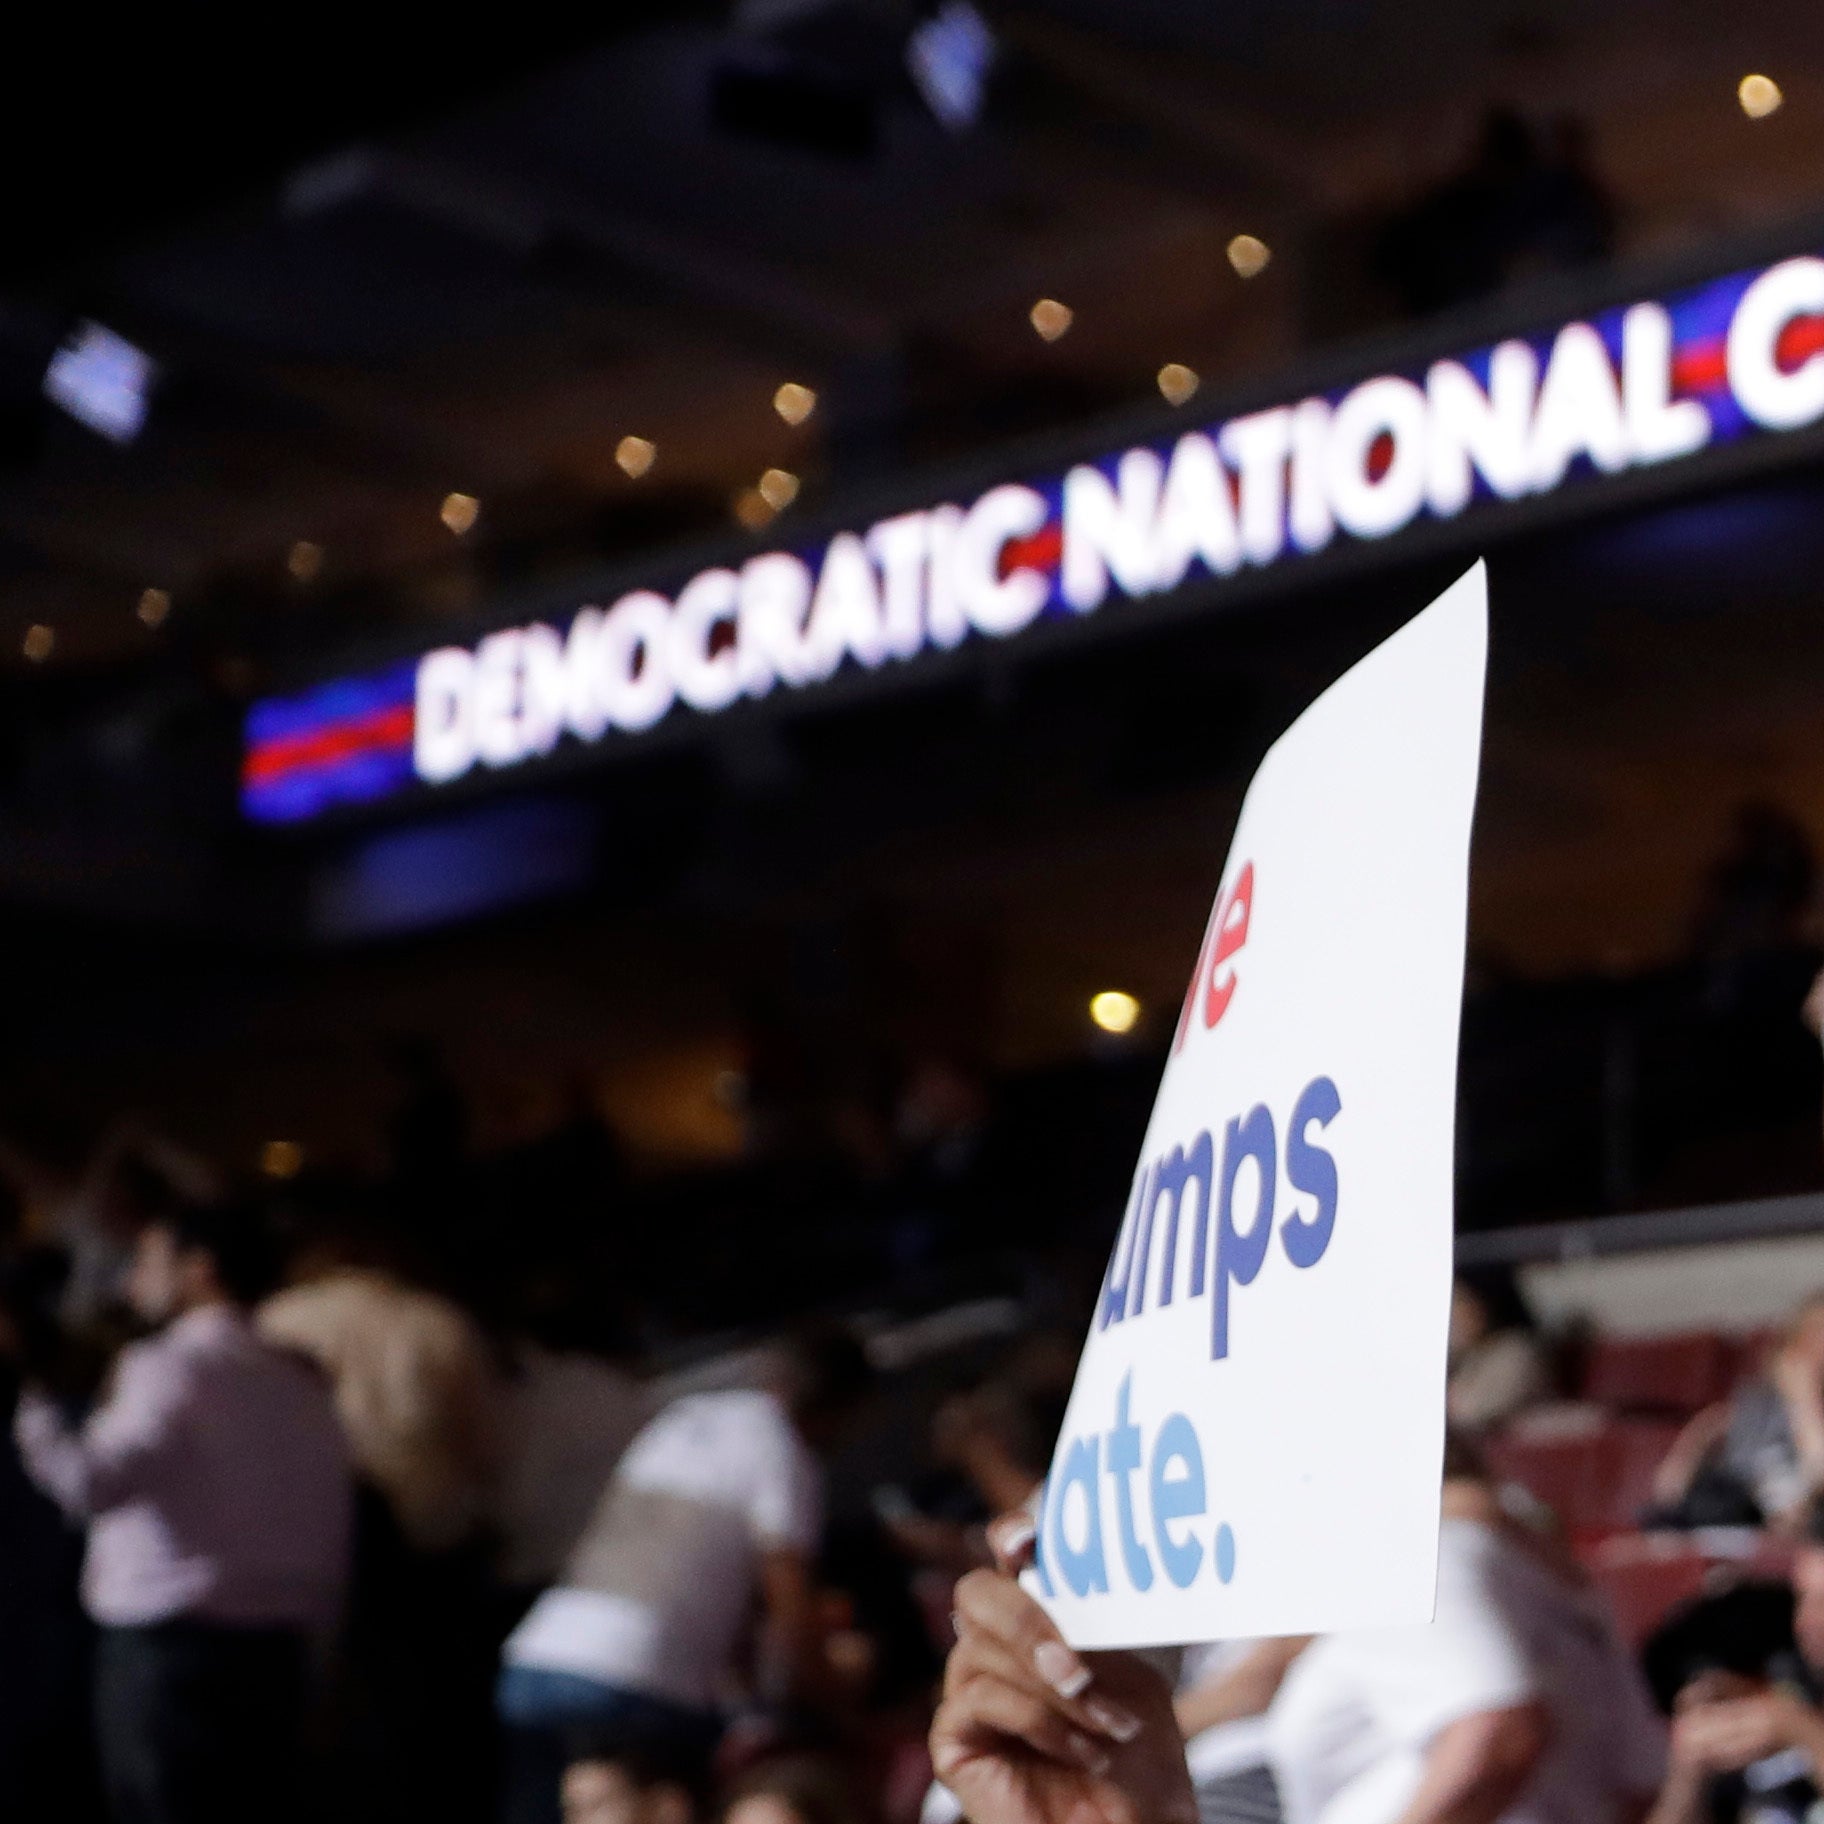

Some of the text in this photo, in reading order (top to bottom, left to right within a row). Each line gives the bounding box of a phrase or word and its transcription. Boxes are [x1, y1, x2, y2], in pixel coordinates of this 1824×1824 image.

[413, 482, 1052, 787] DEMOCRATIC
[1061, 300, 1712, 614] NATIONAL
[1035, 1366, 1237, 1599] ate.
